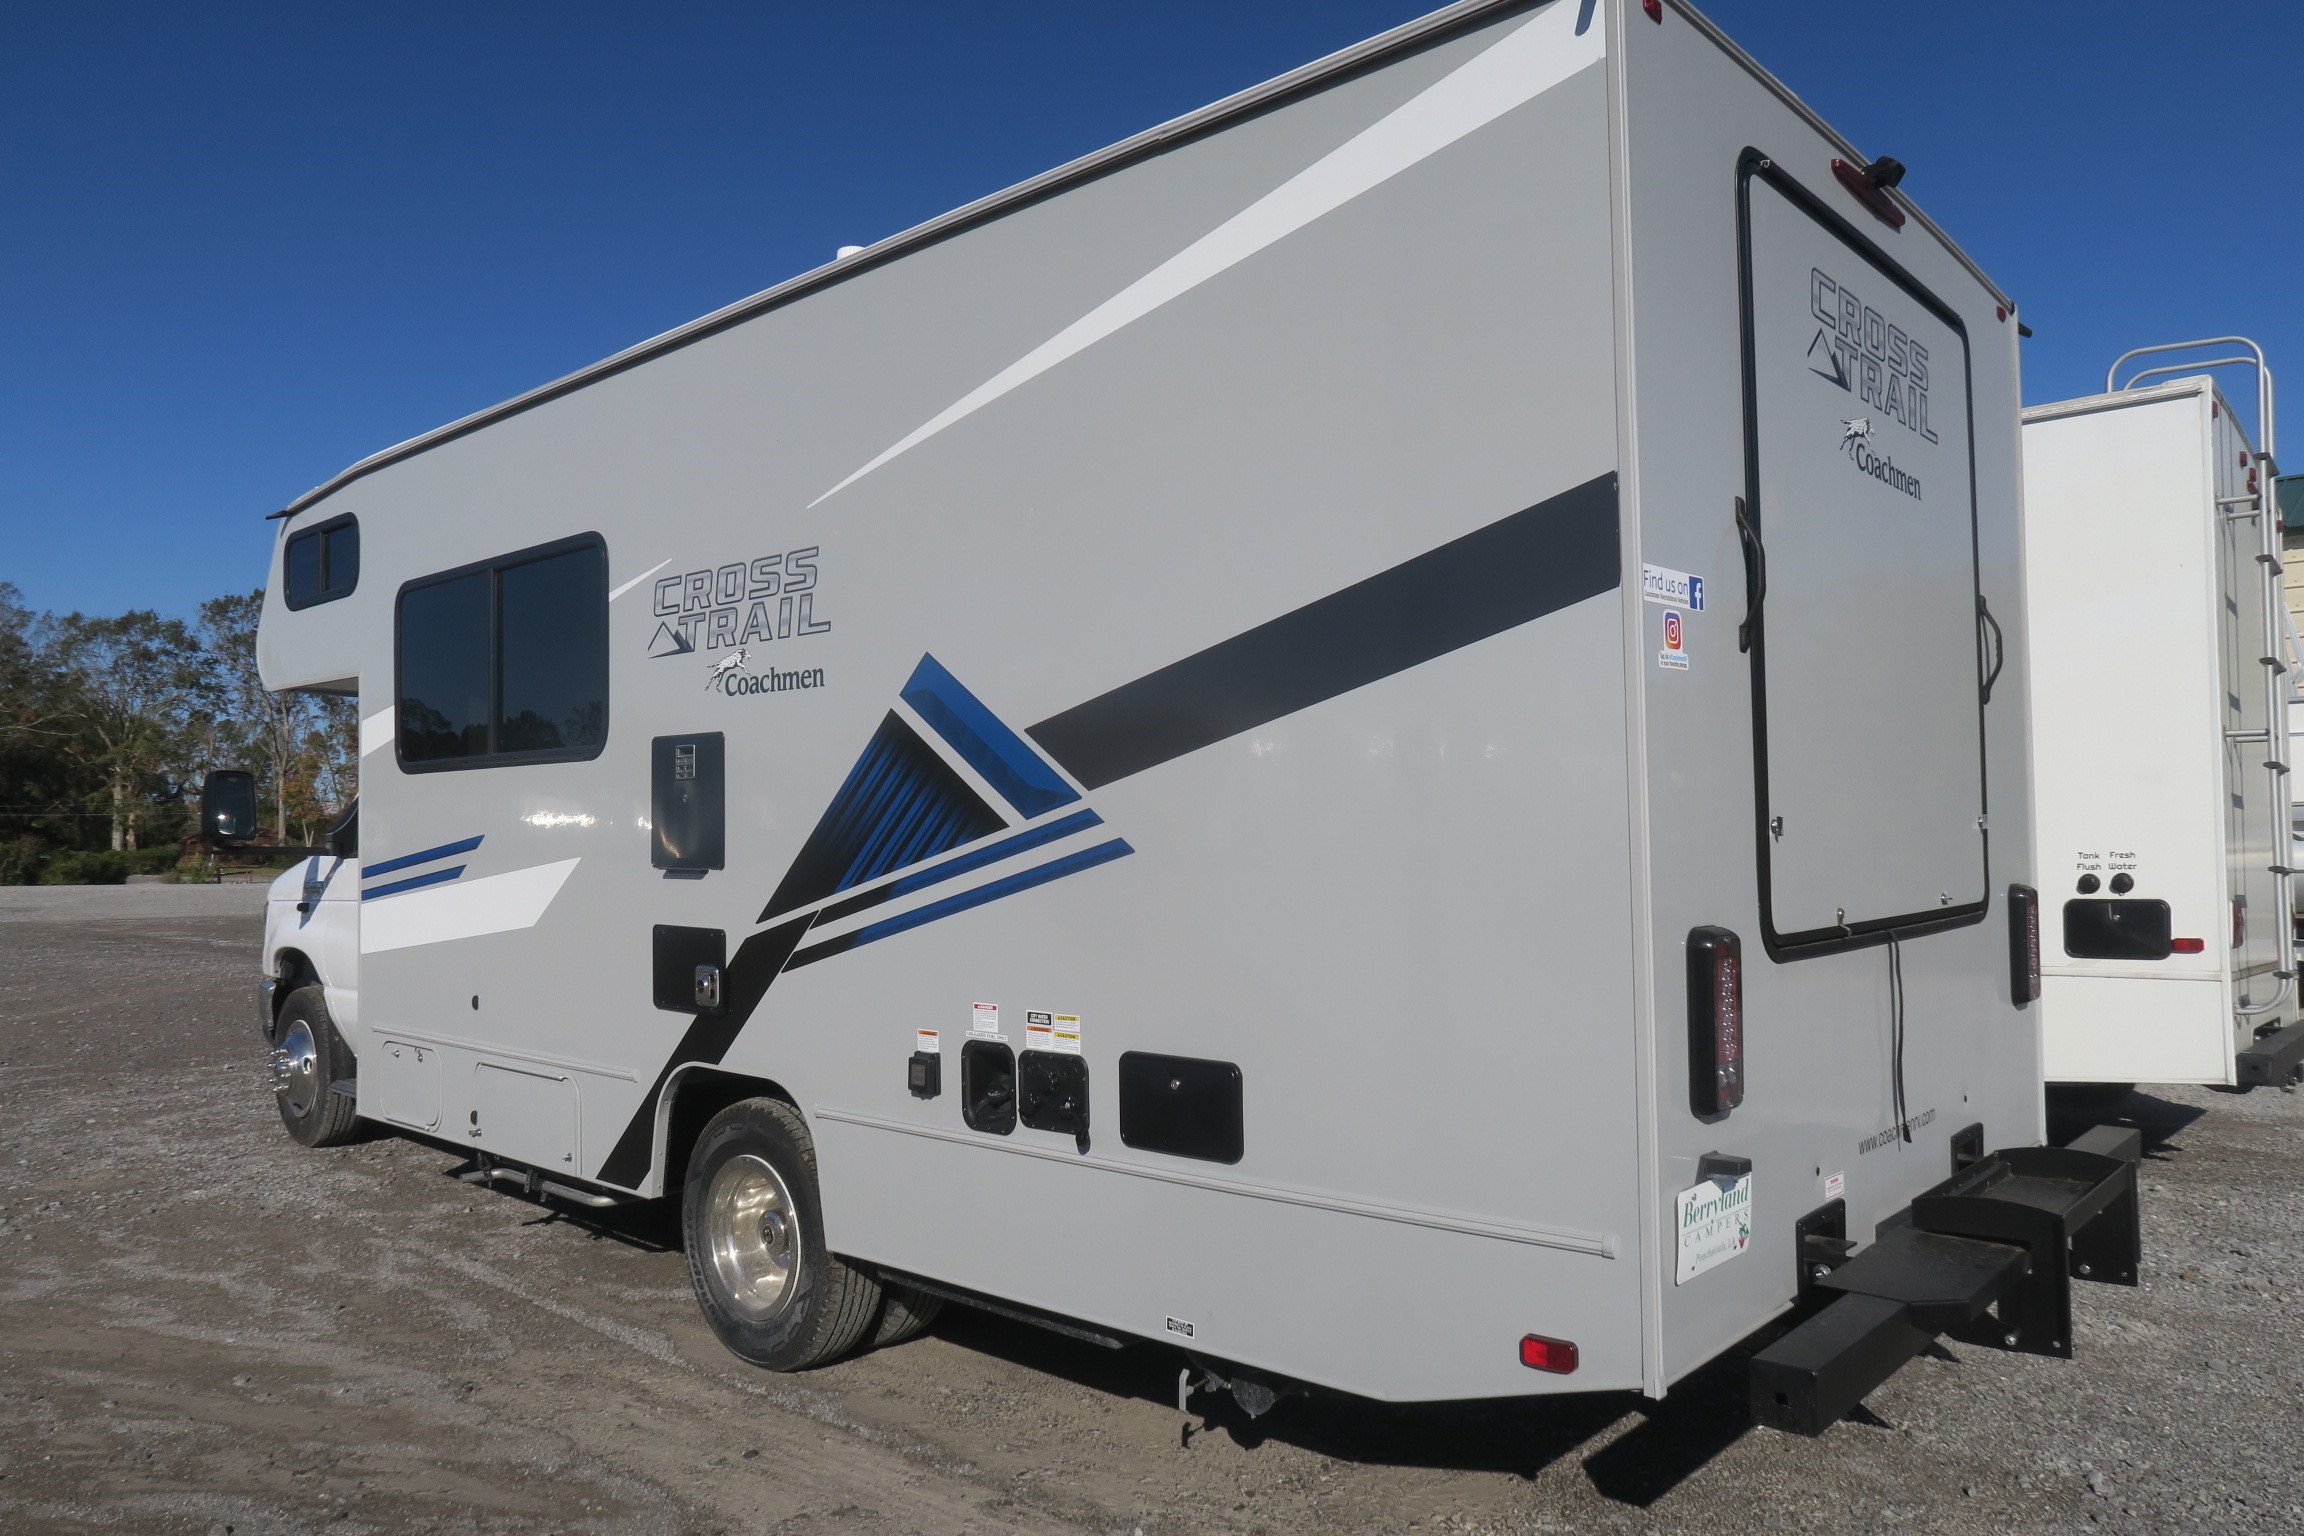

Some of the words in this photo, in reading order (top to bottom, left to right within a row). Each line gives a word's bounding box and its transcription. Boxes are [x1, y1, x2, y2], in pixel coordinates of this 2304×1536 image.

[1811, 267, 1928, 391] CROSS
[1834, 335, 1938, 445] TRAIL
[1856, 443, 1921, 500] Coachmen
[654, 546, 819, 617] CROSS
[1643, 569, 1663, 590] Find
[1666, 579, 1675, 593] us
[1677, 581, 1688, 596] on
[677, 592, 831, 651] TRAIL
[724, 667, 825, 696] Coachmen
[2076, 863, 2101, 871] Flush
[2077, 851, 2100, 860] Tank
[2109, 851, 2136, 859] Fresh
[1859, 1108, 1936, 1155] www.coacenrv.com
[1684, 1178, 1749, 1228] Berryland
[1684, 1209, 1749, 1247] CAMPERS
